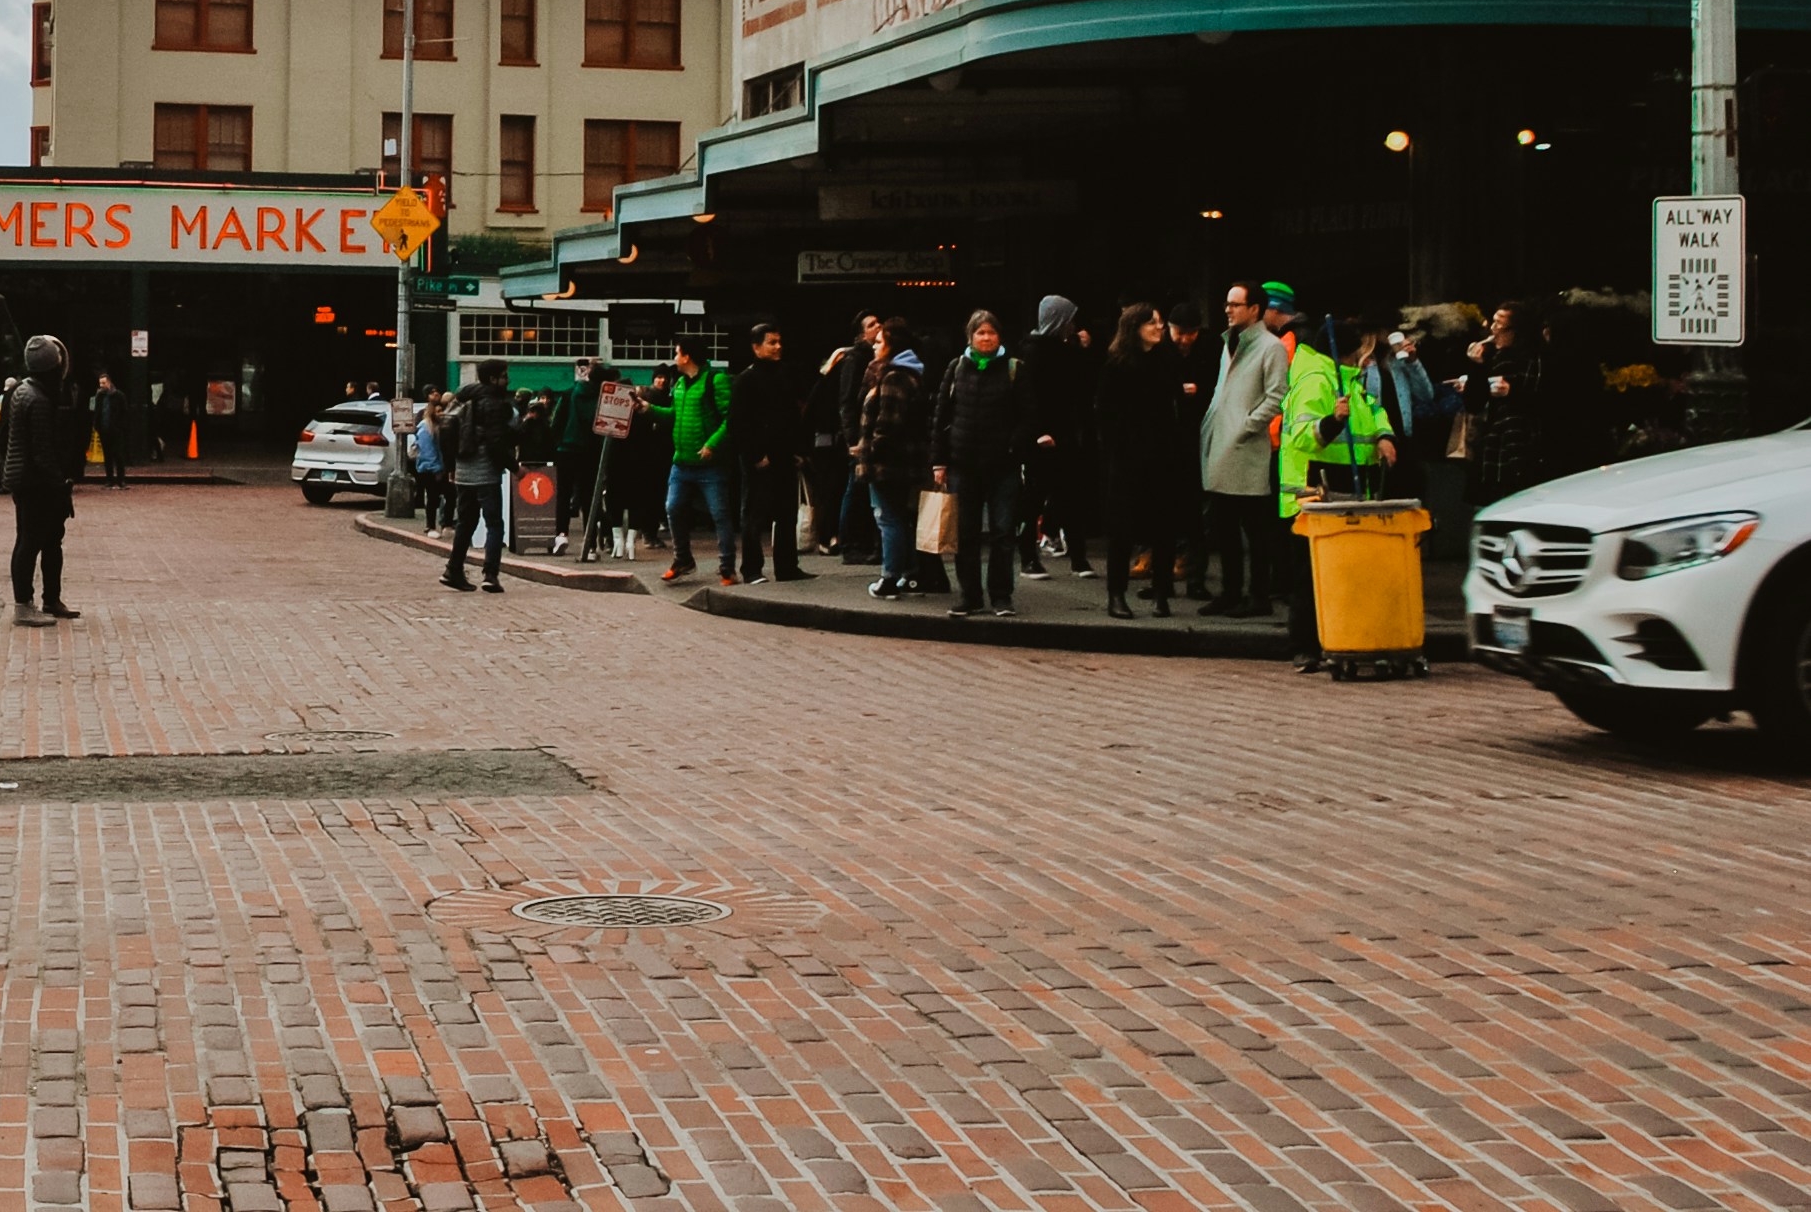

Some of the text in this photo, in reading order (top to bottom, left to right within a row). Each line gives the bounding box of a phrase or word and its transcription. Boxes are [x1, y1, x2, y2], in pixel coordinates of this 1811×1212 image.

[395, 198, 417, 207] YIELD
[401, 208, 410, 217] TO
[1665, 208, 1733, 225] ALL WAY
[378, 218, 431, 227] PEDESTRIANS
[1679, 232, 1719, 248] WALK
[805, 253, 835, 271] The
[417, 278, 443, 292] Pike
[603, 395, 631, 408] STOPS
